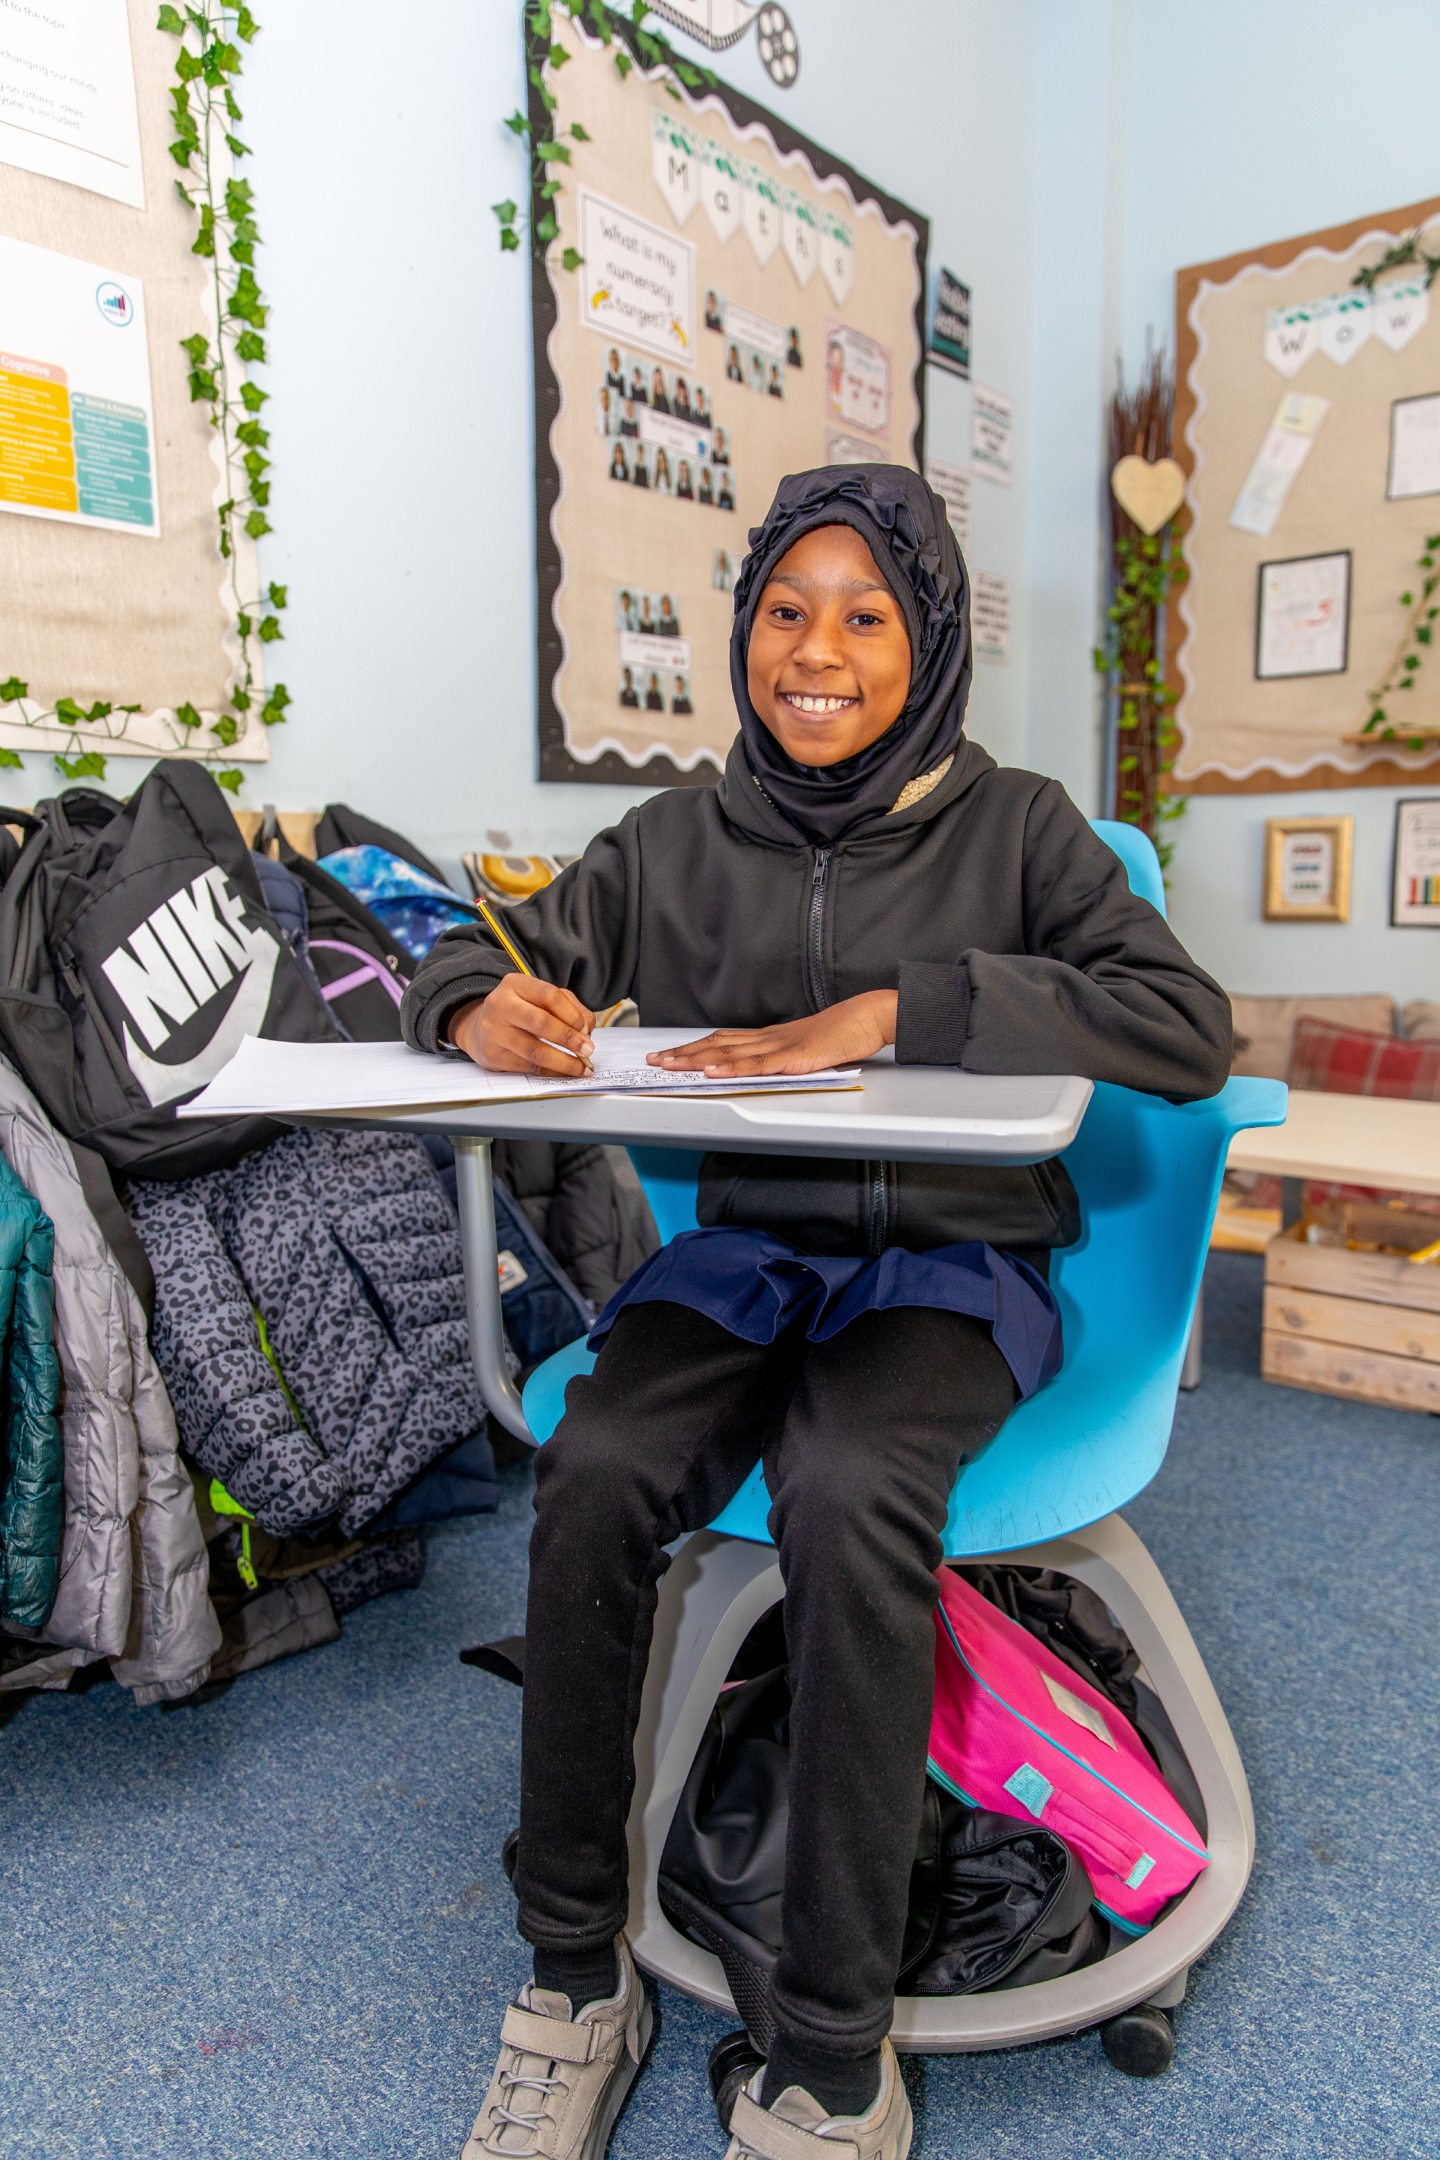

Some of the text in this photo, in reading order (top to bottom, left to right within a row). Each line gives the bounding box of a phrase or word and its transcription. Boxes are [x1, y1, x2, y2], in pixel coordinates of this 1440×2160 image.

[599, 216, 677, 278] What is my
[668, 154, 845, 278] Maths
[606, 260, 674, 308] numeracy
[101, 864, 258, 1052] NIKE
